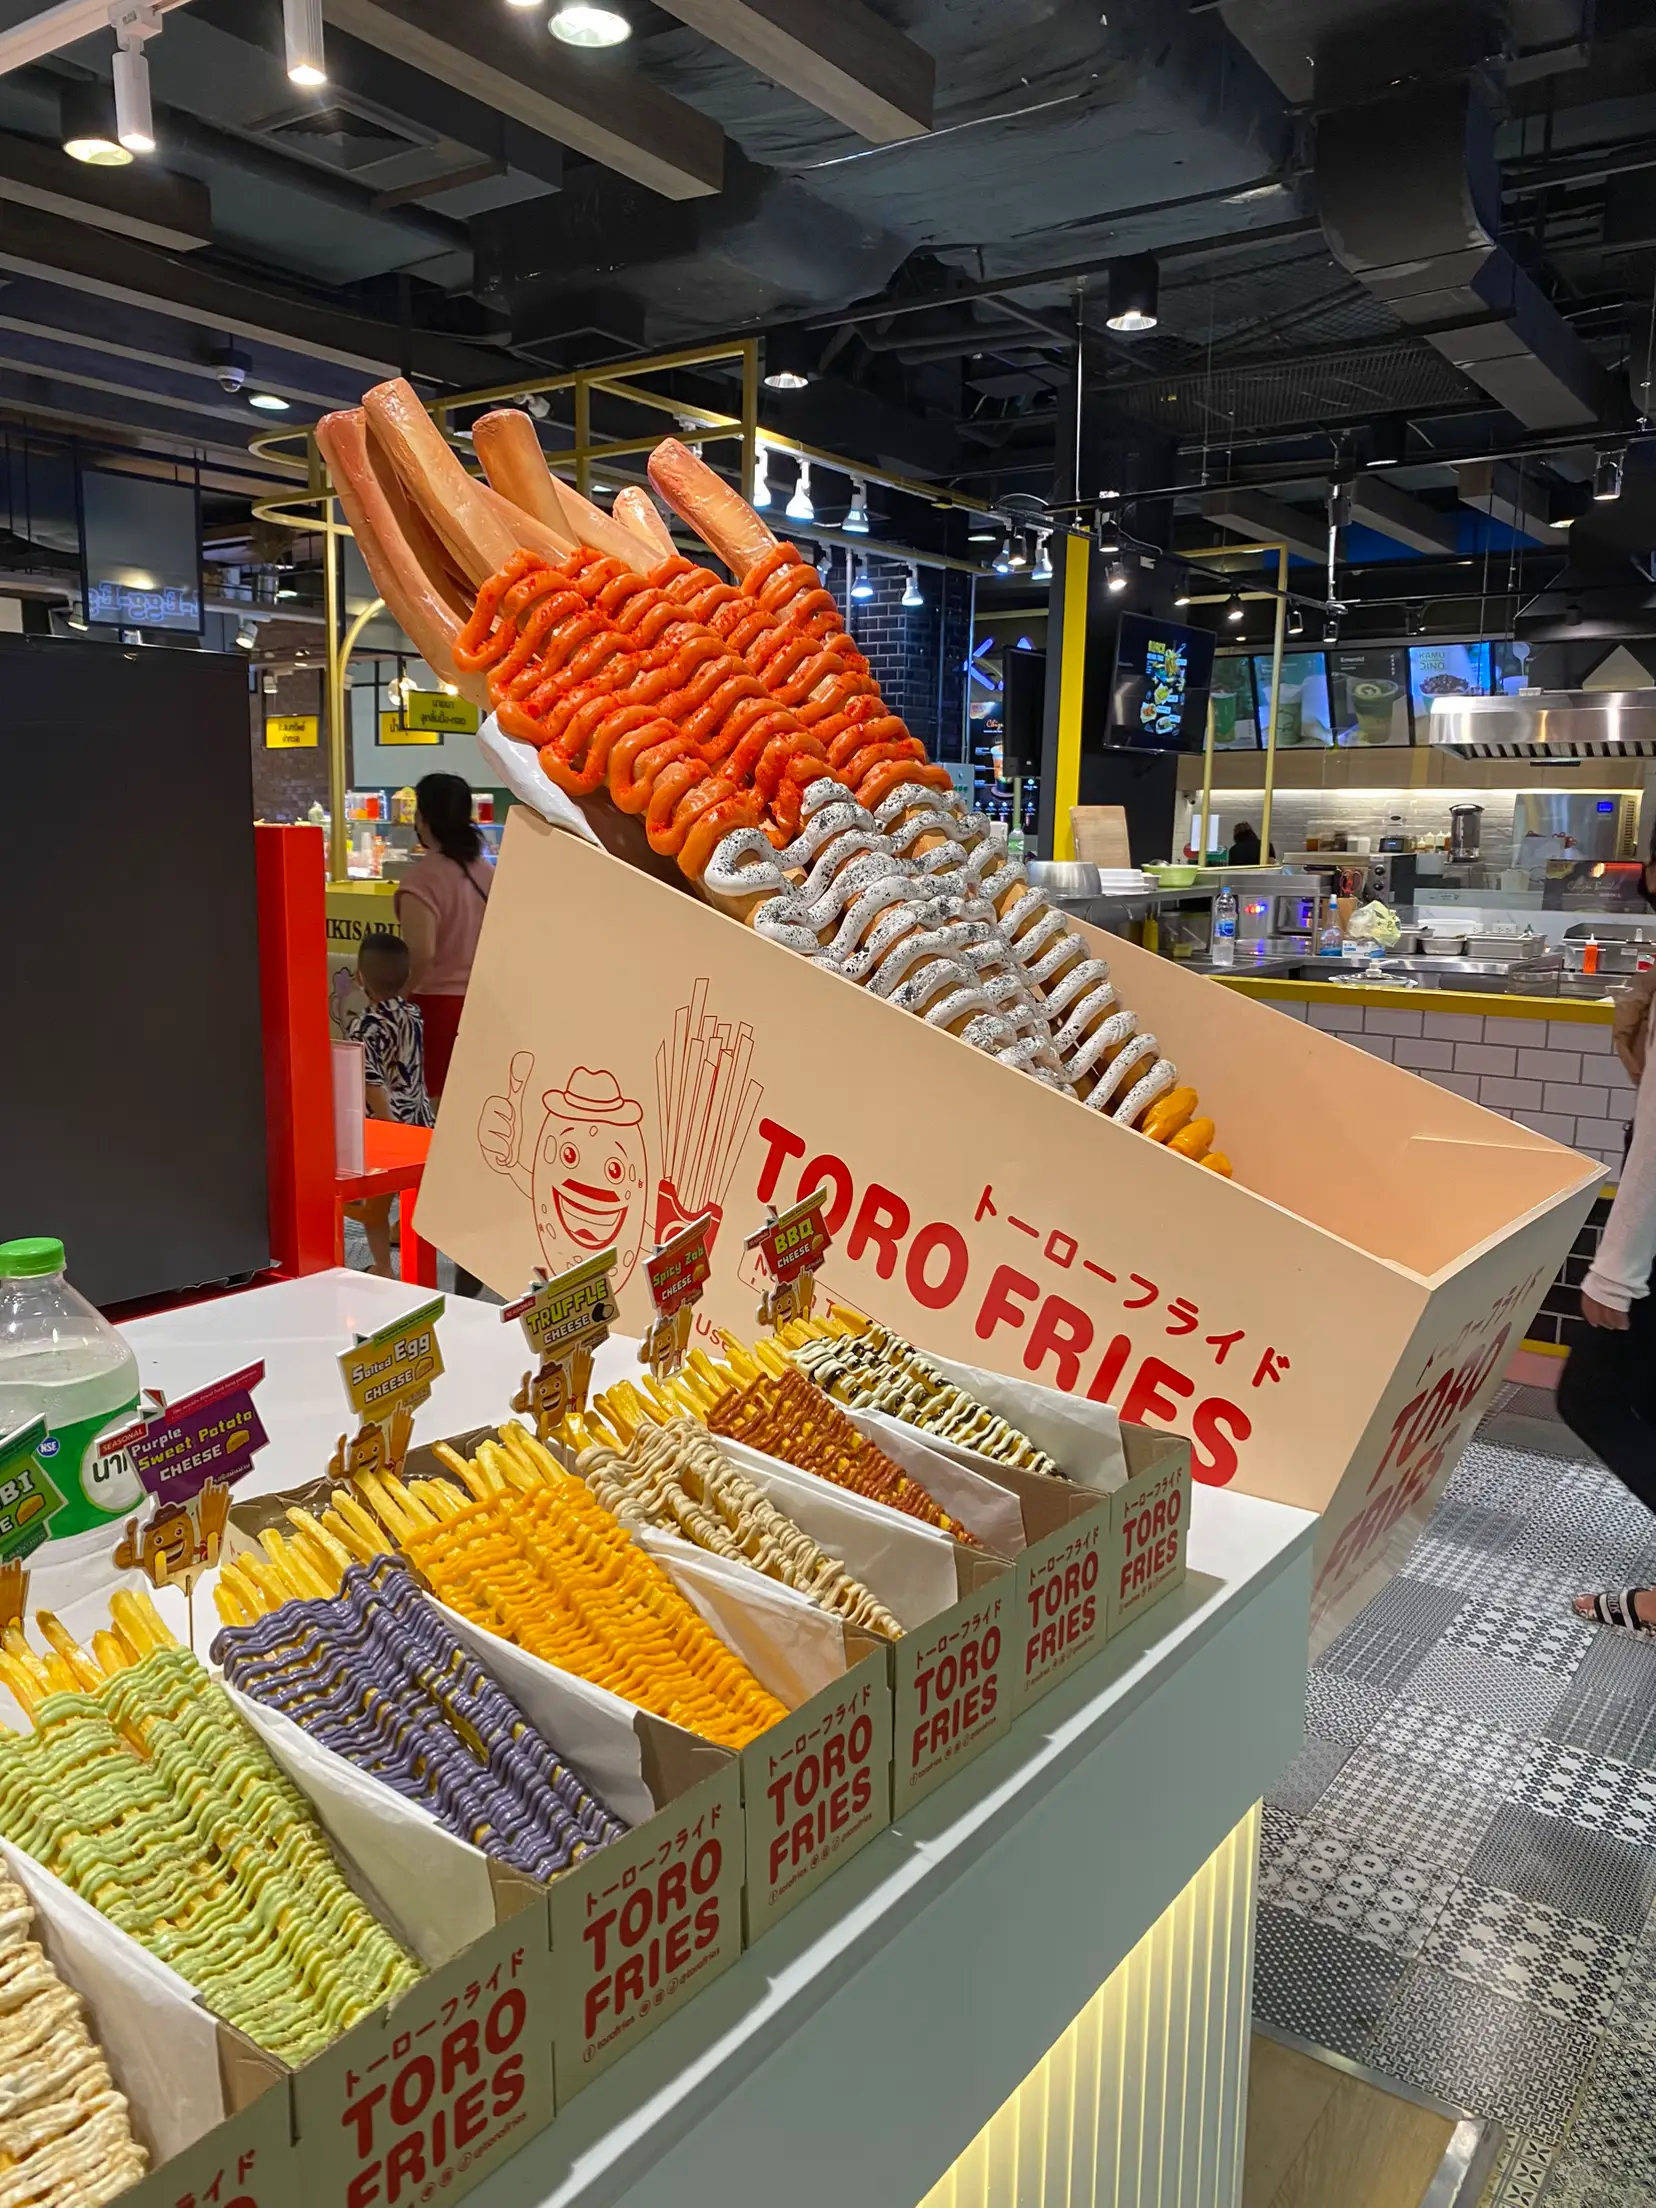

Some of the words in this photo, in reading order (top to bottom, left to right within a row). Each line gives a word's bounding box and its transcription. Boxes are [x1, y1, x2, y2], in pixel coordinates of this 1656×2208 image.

[1419, 652, 1445, 660] KAMU
[775, 1218, 815, 1254] BBQ
[777, 1243, 811, 1268] CHEESE
[526, 1278, 608, 1335] TRUFFLE
[653, 1262, 682, 1287] Spicy
[661, 1274, 692, 1300] CHEESE
[754, 1117, 969, 1310] TORO
[975, 1264, 1252, 1487] FRIES
[975, 1184, 1292, 1388] トーローフライド
[353, 1356, 392, 1386] Salted
[394, 1332, 431, 1363] Egg
[544, 1314, 590, 1344] CHEESE
[364, 1369, 414, 1404] CHEESE
[102, 1428, 145, 1451] SEASONAL
[131, 1428, 182, 1457] Purple
[138, 1436, 193, 1471] Sweet
[198, 1411, 253, 1442] Potato
[159, 1444, 223, 1482] CHEESE
[1123, 1489, 1181, 1557] TORO
[1028, 1551, 1098, 1628] TORO
[1120, 1529, 1178, 1599] FRIES
[1026, 1594, 1096, 1675] FRIES
[913, 1625, 1001, 1716] TORO
[912, 1673, 998, 1768] FRIES
[767, 1714, 873, 1827] TORO
[769, 1766, 871, 1885] FRIES
[583, 1838, 722, 1972] TORO
[585, 1896, 720, 2039] FRIES
[342, 1988, 526, 2159] TORO
[347, 2053, 525, 2208] FRIES
